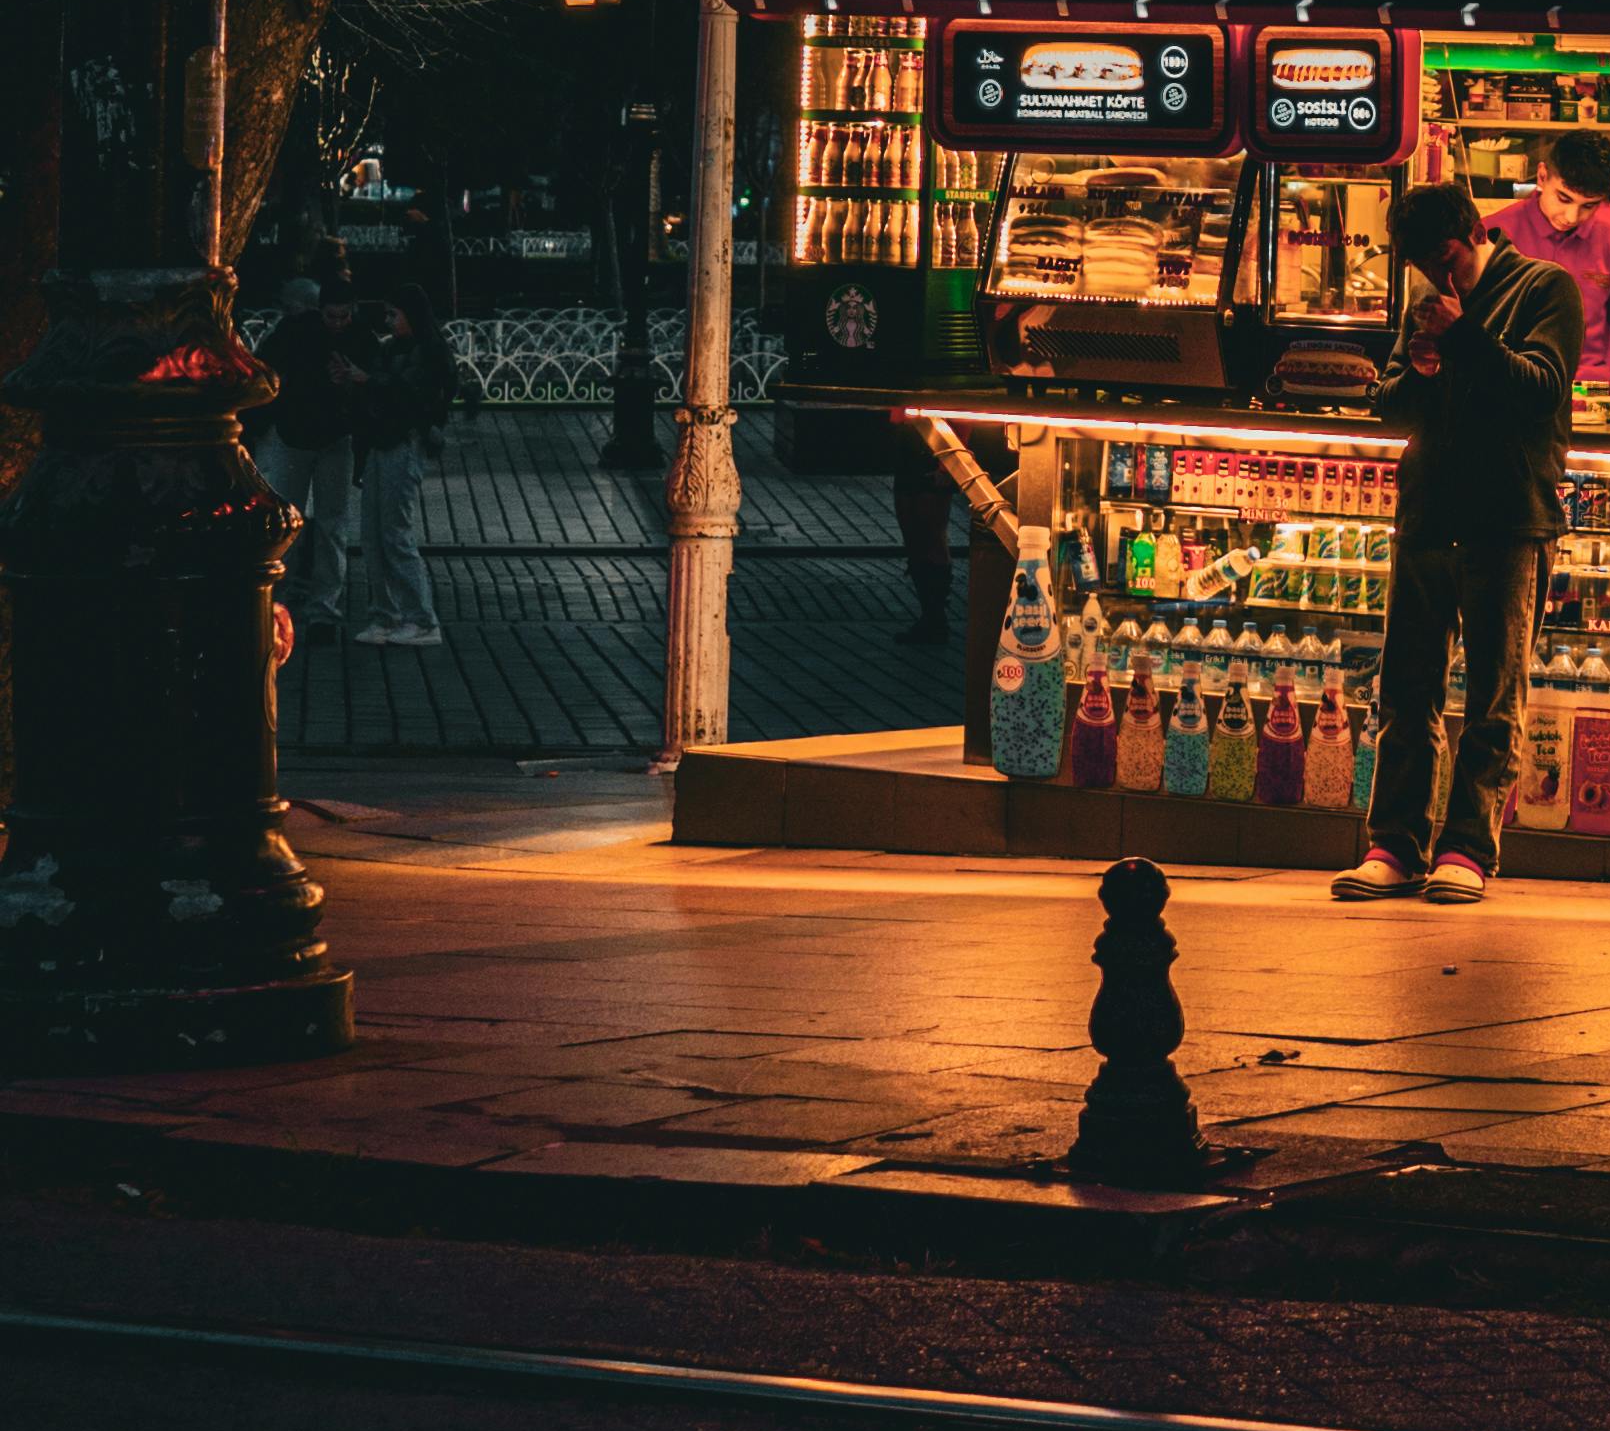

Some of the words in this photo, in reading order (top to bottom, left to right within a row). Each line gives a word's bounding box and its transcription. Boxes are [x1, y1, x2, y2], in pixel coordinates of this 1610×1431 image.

[1019, 94, 1105, 108] SULTANAHMET
[1106, 93, 1146, 110] KÖFTE
[945, 190, 991, 200] STARBUCKS
